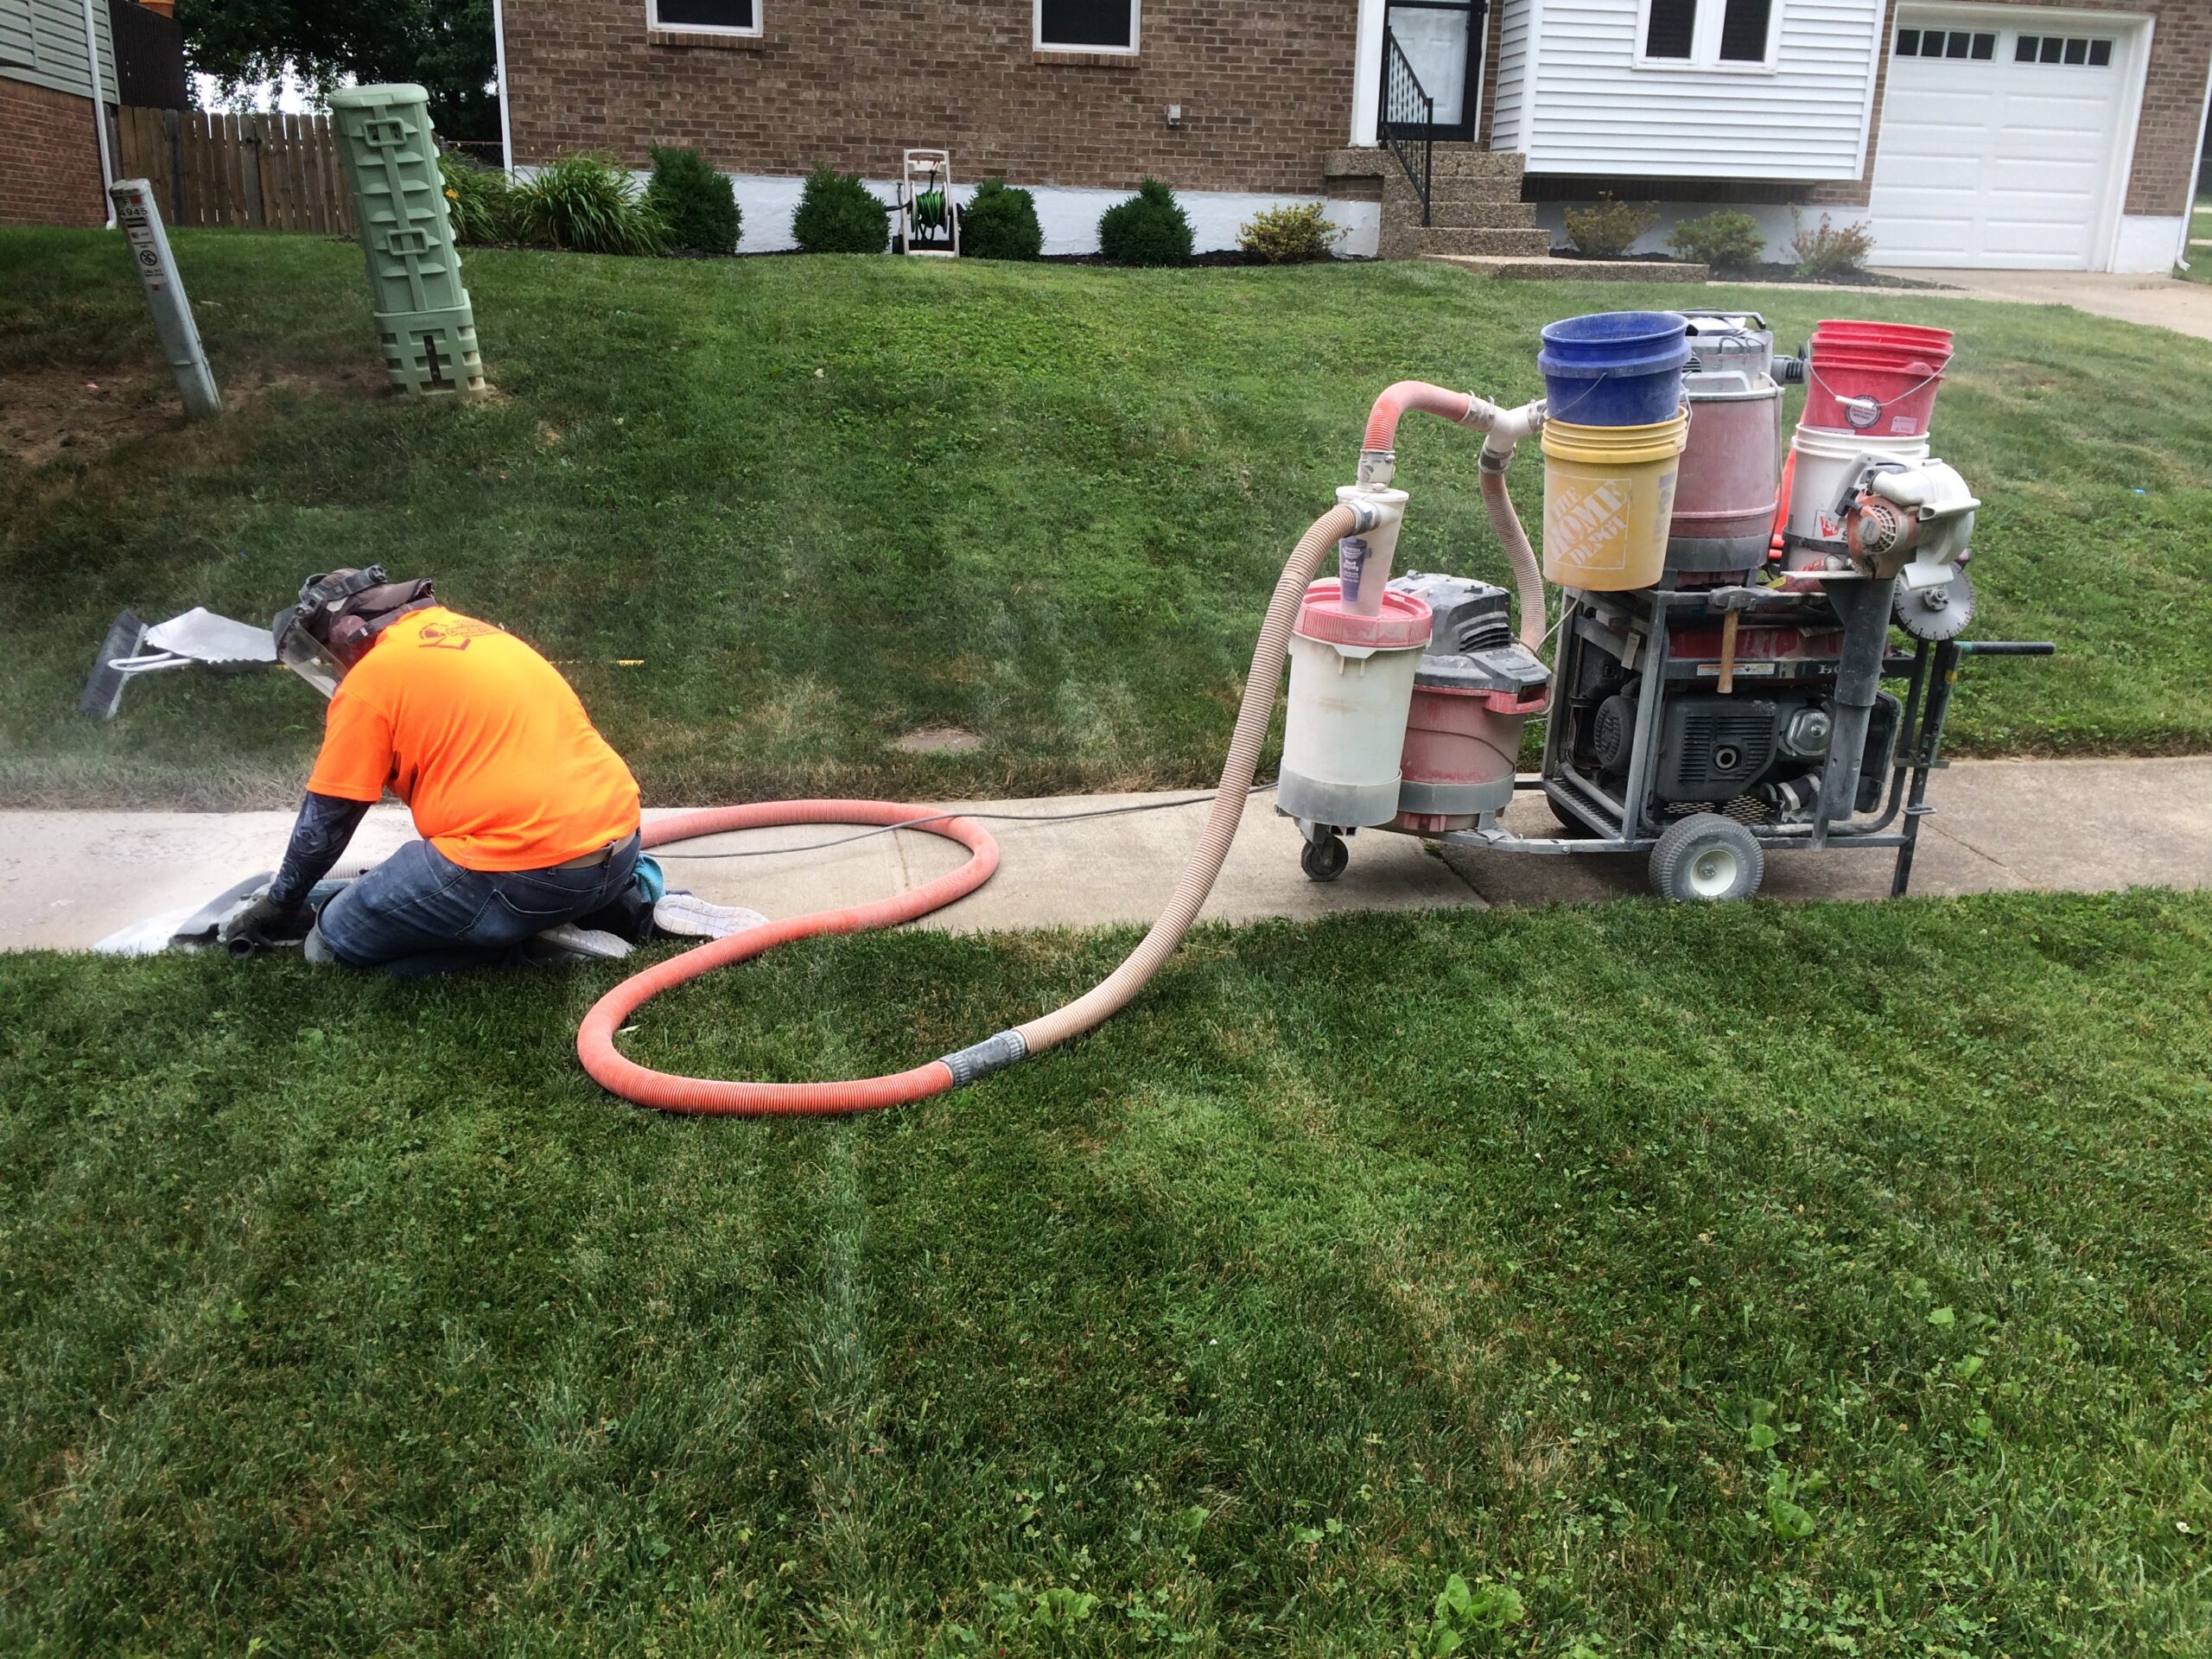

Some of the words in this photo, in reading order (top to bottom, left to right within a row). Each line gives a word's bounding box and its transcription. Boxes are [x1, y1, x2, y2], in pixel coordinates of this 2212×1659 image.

[1548, 480, 1627, 562] HOME
[1552, 486, 1579, 519] THE
[1570, 515, 1628, 566] DEPOT
